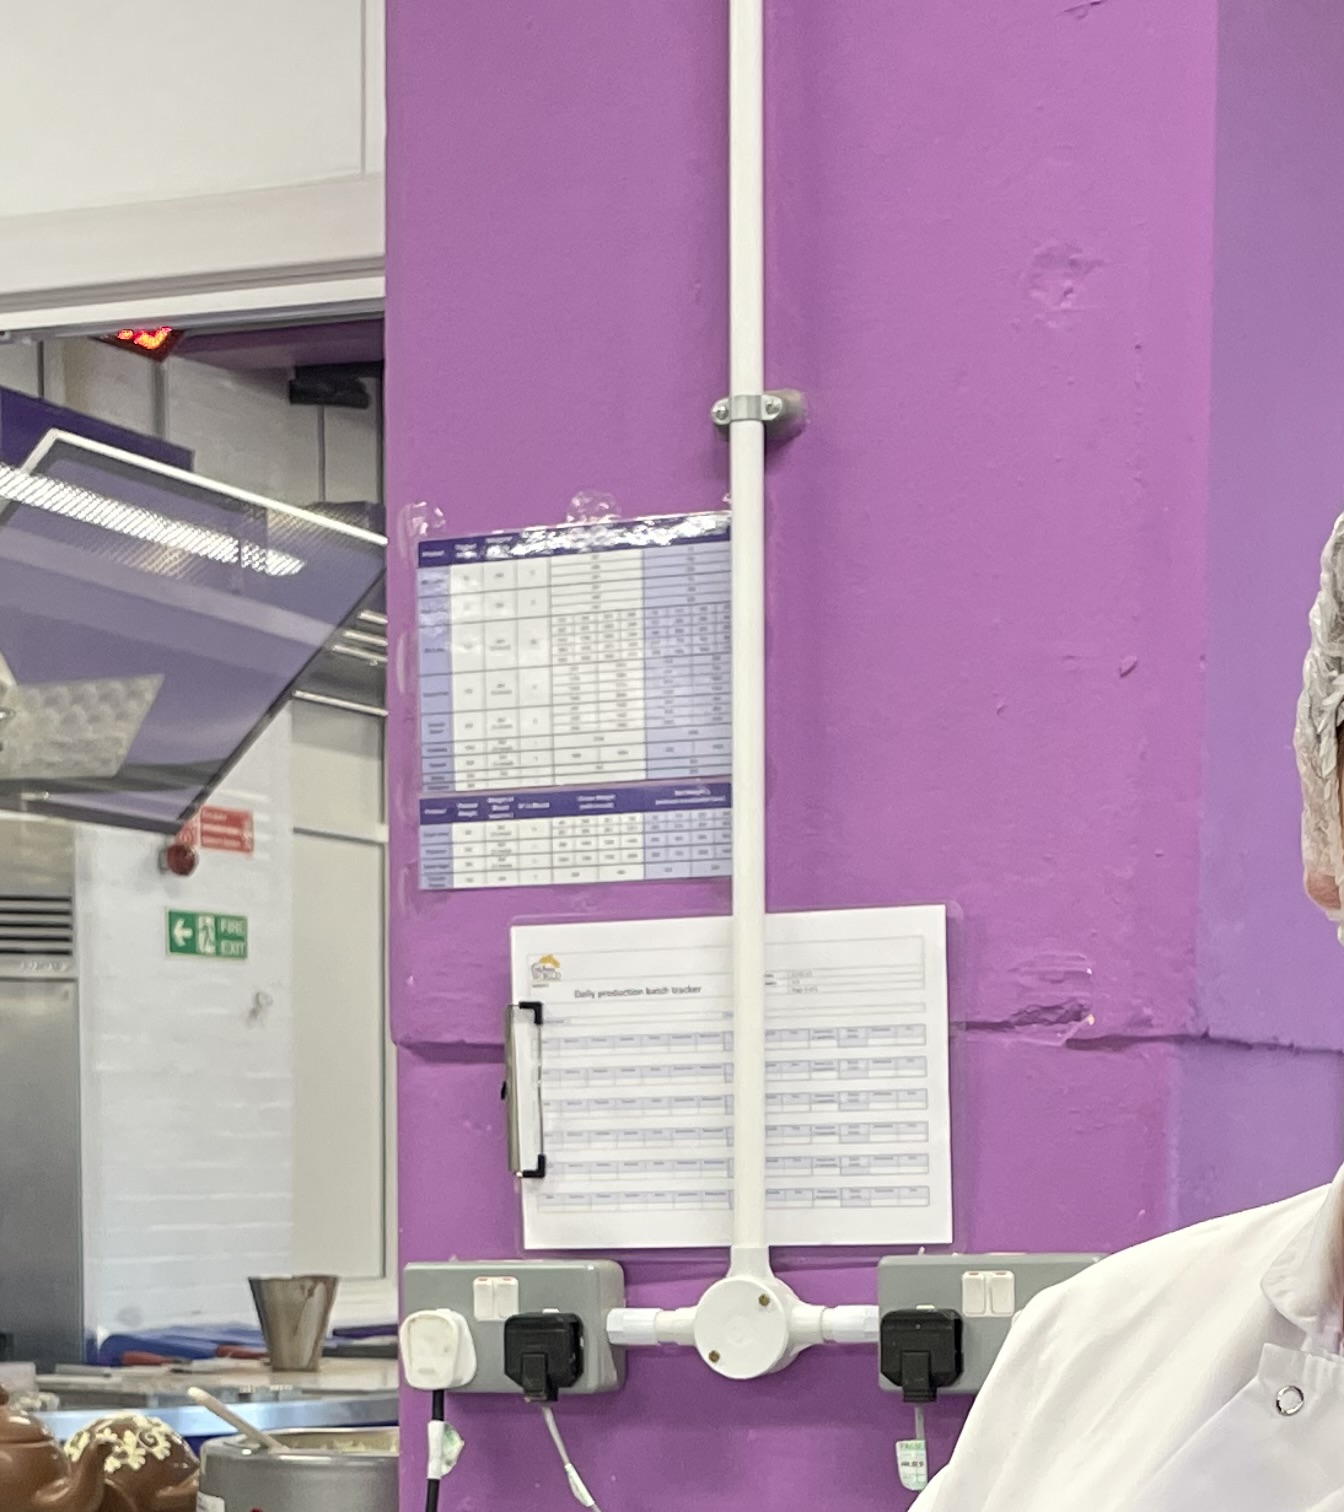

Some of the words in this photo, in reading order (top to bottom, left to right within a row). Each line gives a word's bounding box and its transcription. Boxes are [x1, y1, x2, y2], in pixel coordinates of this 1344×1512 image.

[220, 918, 245, 935] FIRE
[220, 940, 246, 956] EXIT
[597, 988, 644, 998] production
